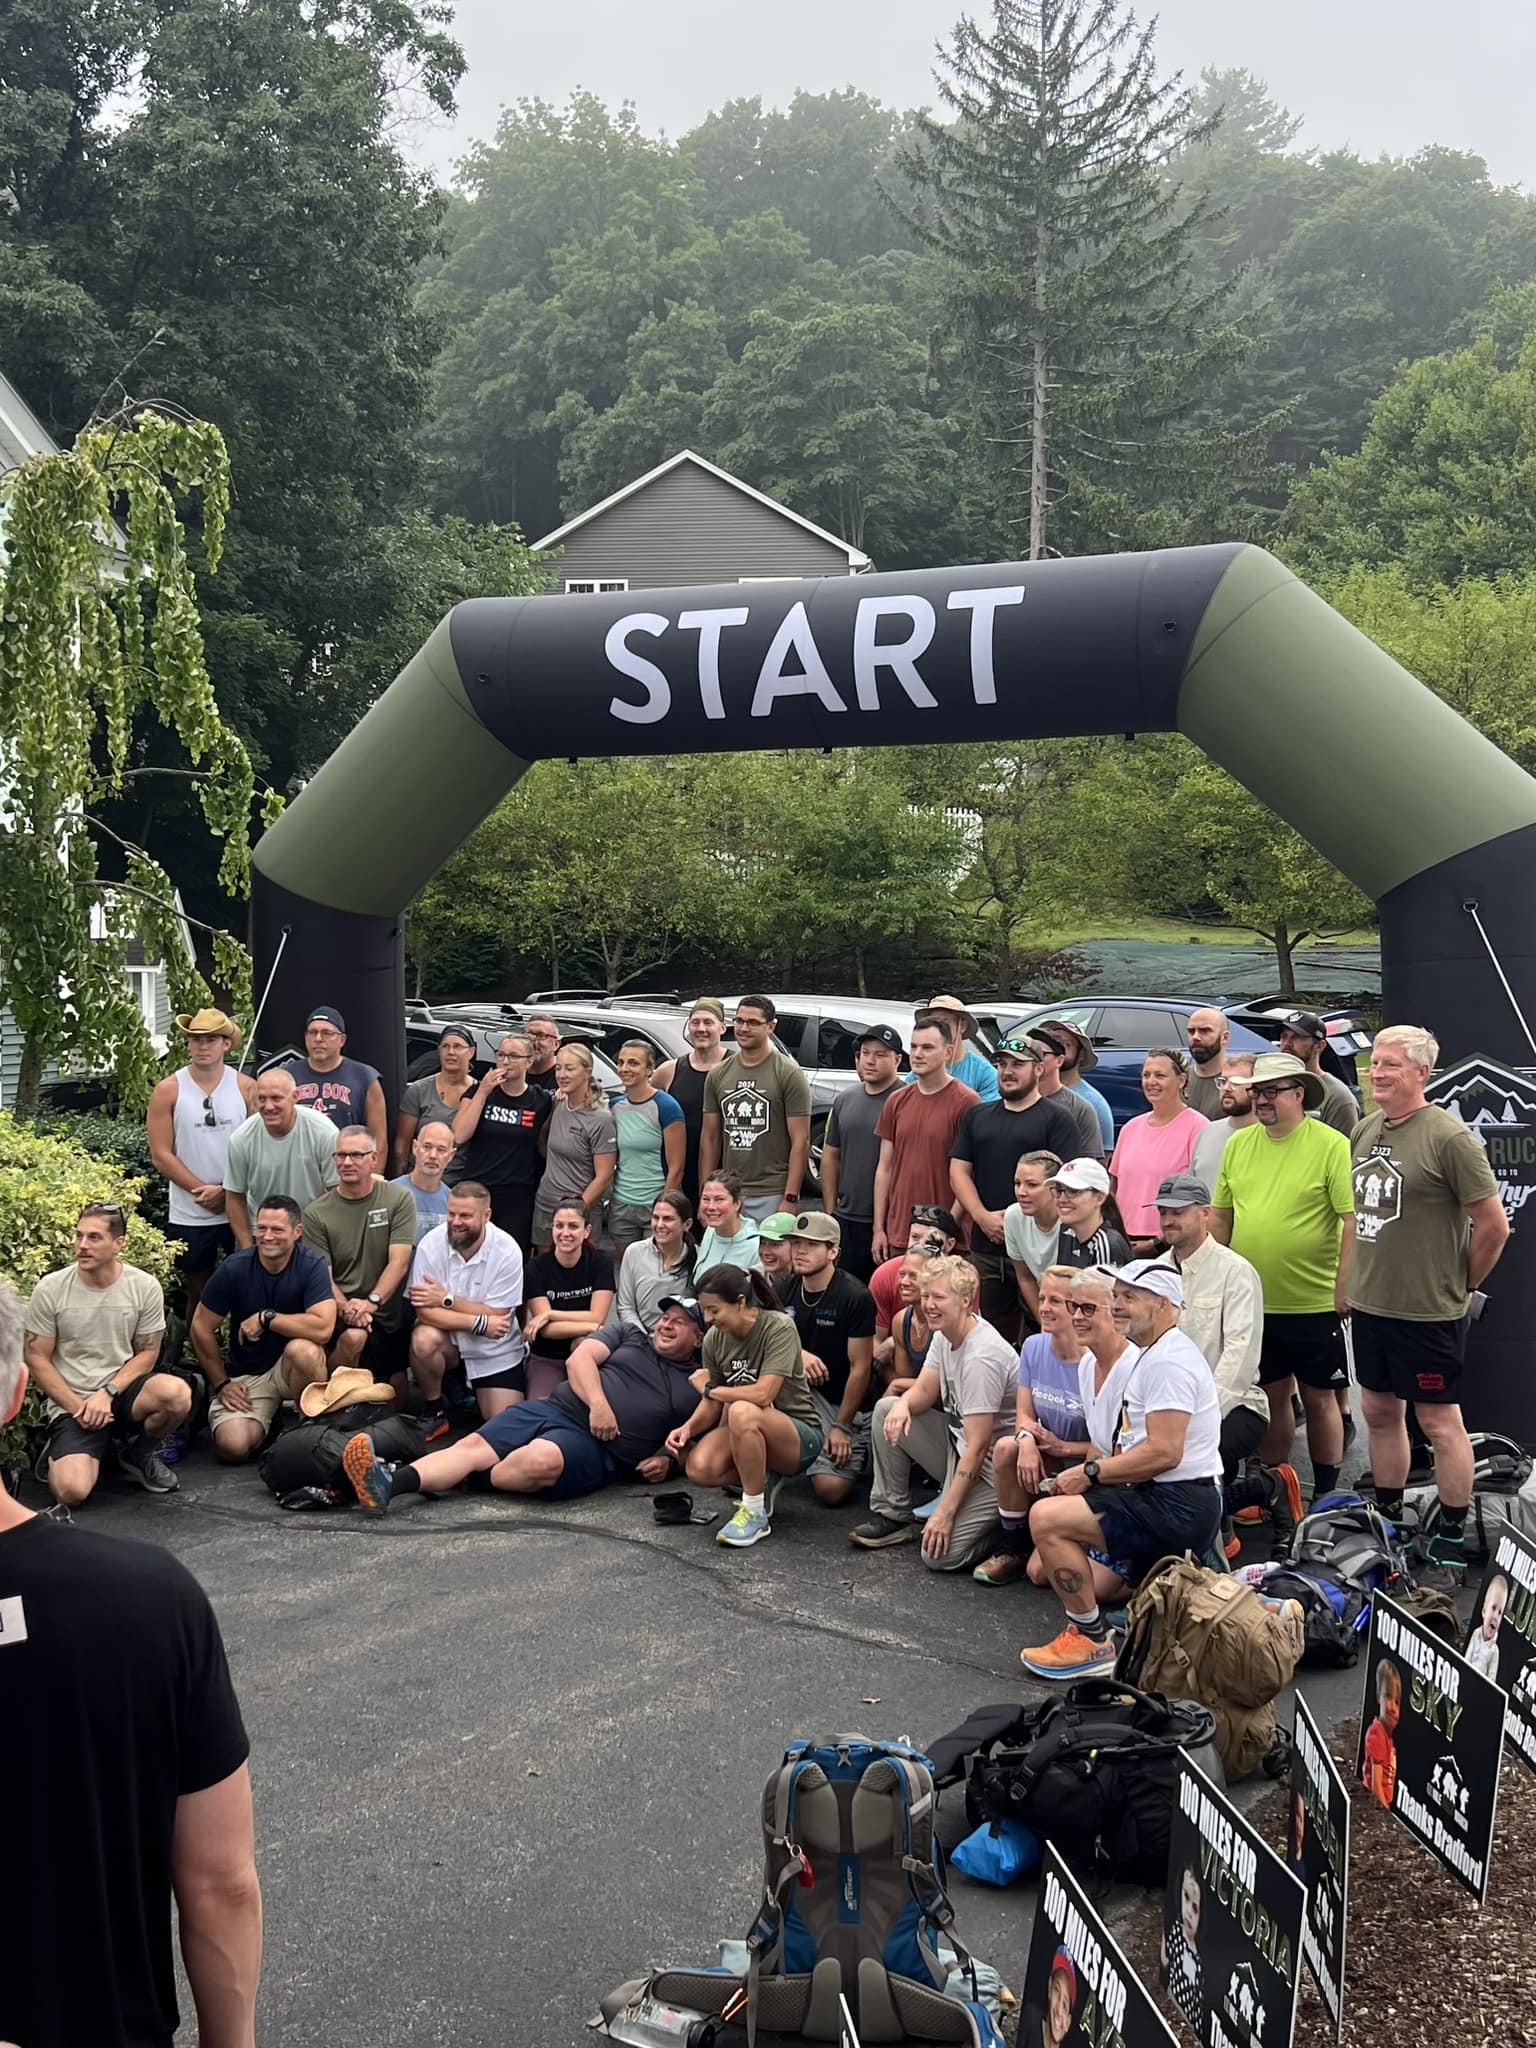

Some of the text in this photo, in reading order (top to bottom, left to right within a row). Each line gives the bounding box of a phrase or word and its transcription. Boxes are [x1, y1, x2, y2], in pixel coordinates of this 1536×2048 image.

[604, 585, 1026, 724] START
[322, 1082, 351, 1105] SOX
[1490, 1136, 1536, 1165] RUC
[1032, 1387, 1066, 1406] Reebok
[1495, 1535, 1517, 1572] 100
[1376, 1608, 1399, 1652] 100
[1398, 1624, 1435, 1682] MILES
[1434, 1654, 1460, 1704] FOR
[1408, 1668, 1463, 1742] SKY
[1180, 1770, 1258, 1896] 100 MILES FOR
[1396, 1779, 1434, 1840] Thanks
[1433, 1816, 1483, 1890] Bradford
[1043, 1871, 1068, 1935] 100
[1063, 1901, 1102, 1992] MILES
[1098, 1956, 1127, 2034] FOR
[1200, 1838, 1292, 1989] VICTORIA
